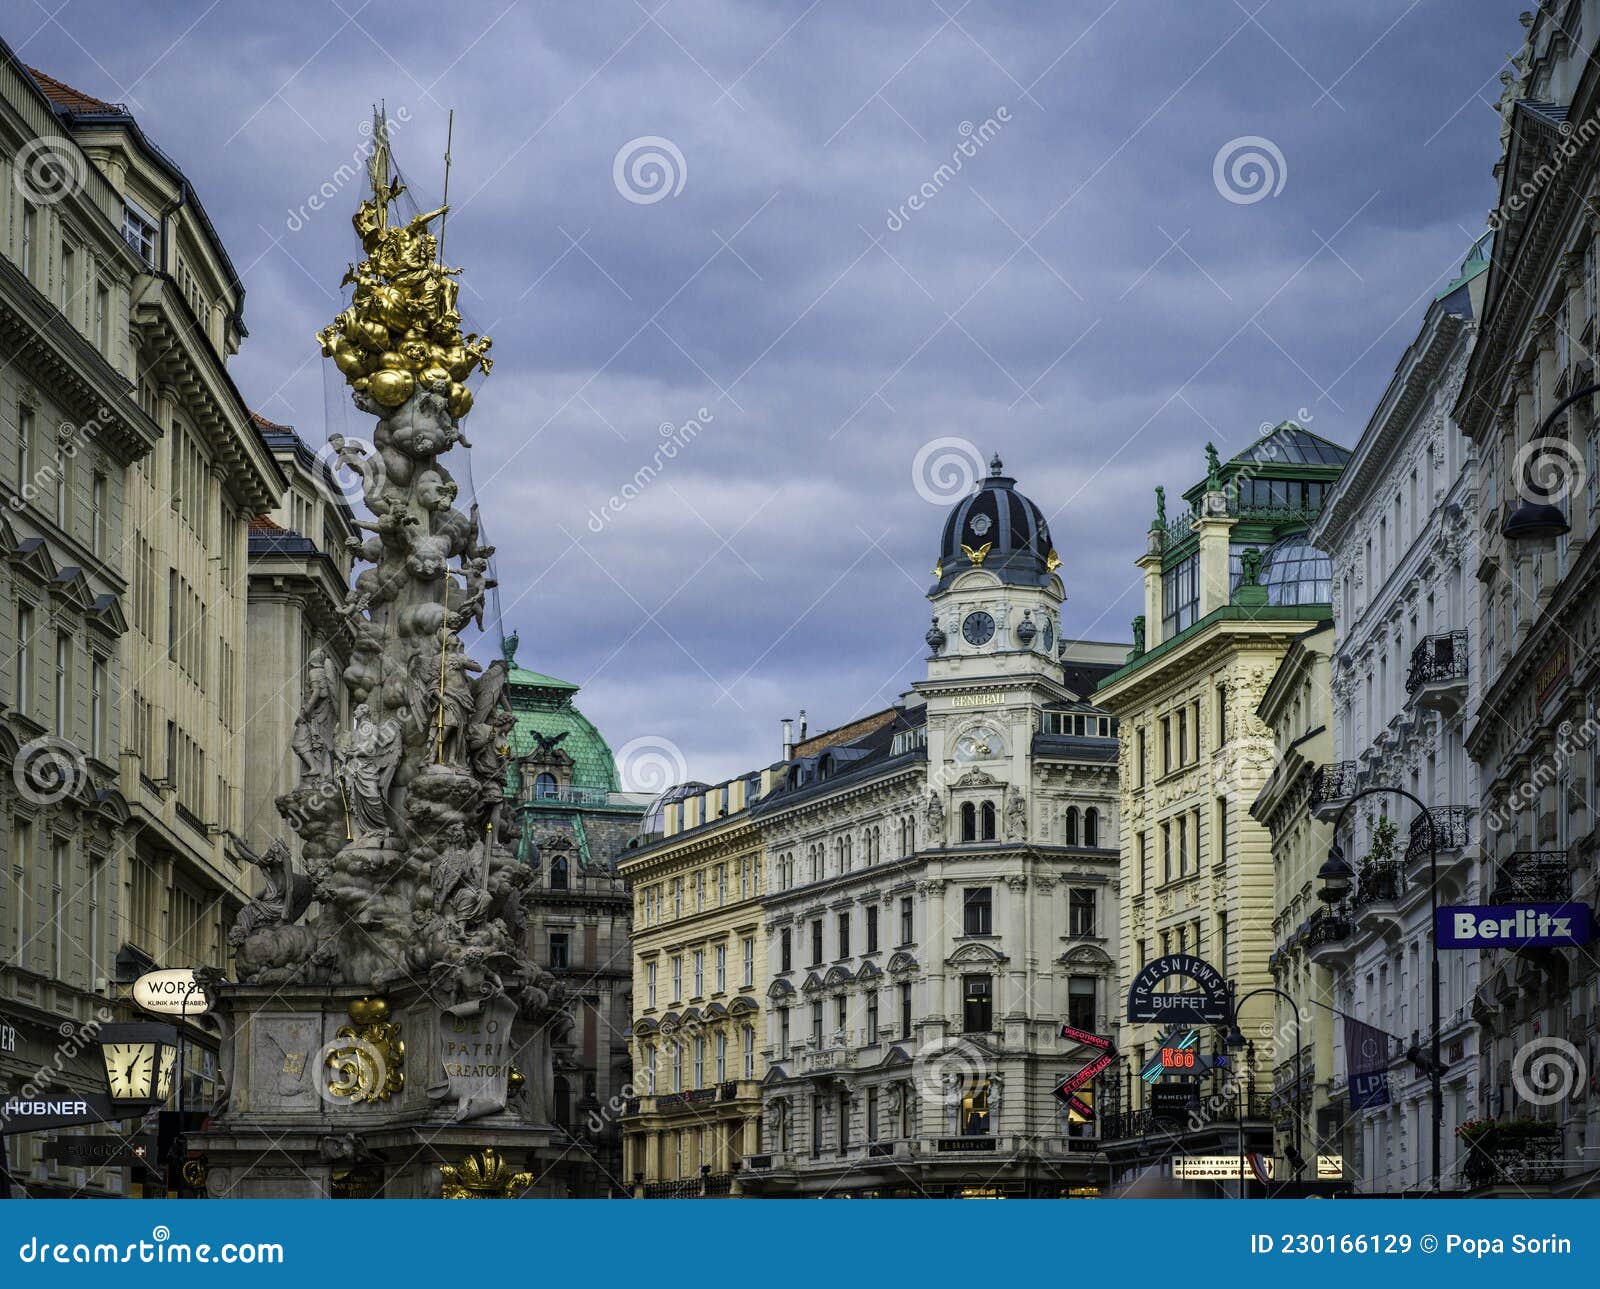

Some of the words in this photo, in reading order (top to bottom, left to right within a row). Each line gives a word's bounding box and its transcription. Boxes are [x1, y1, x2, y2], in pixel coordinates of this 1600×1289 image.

[952, 693, 1005, 706] GENERALI
[1454, 909, 1572, 939] Berlitz
[1153, 996, 1207, 1009] BUFFET
[0, 1024, 15, 1052] ER
[5, 1101, 87, 1116] HÜBNER
